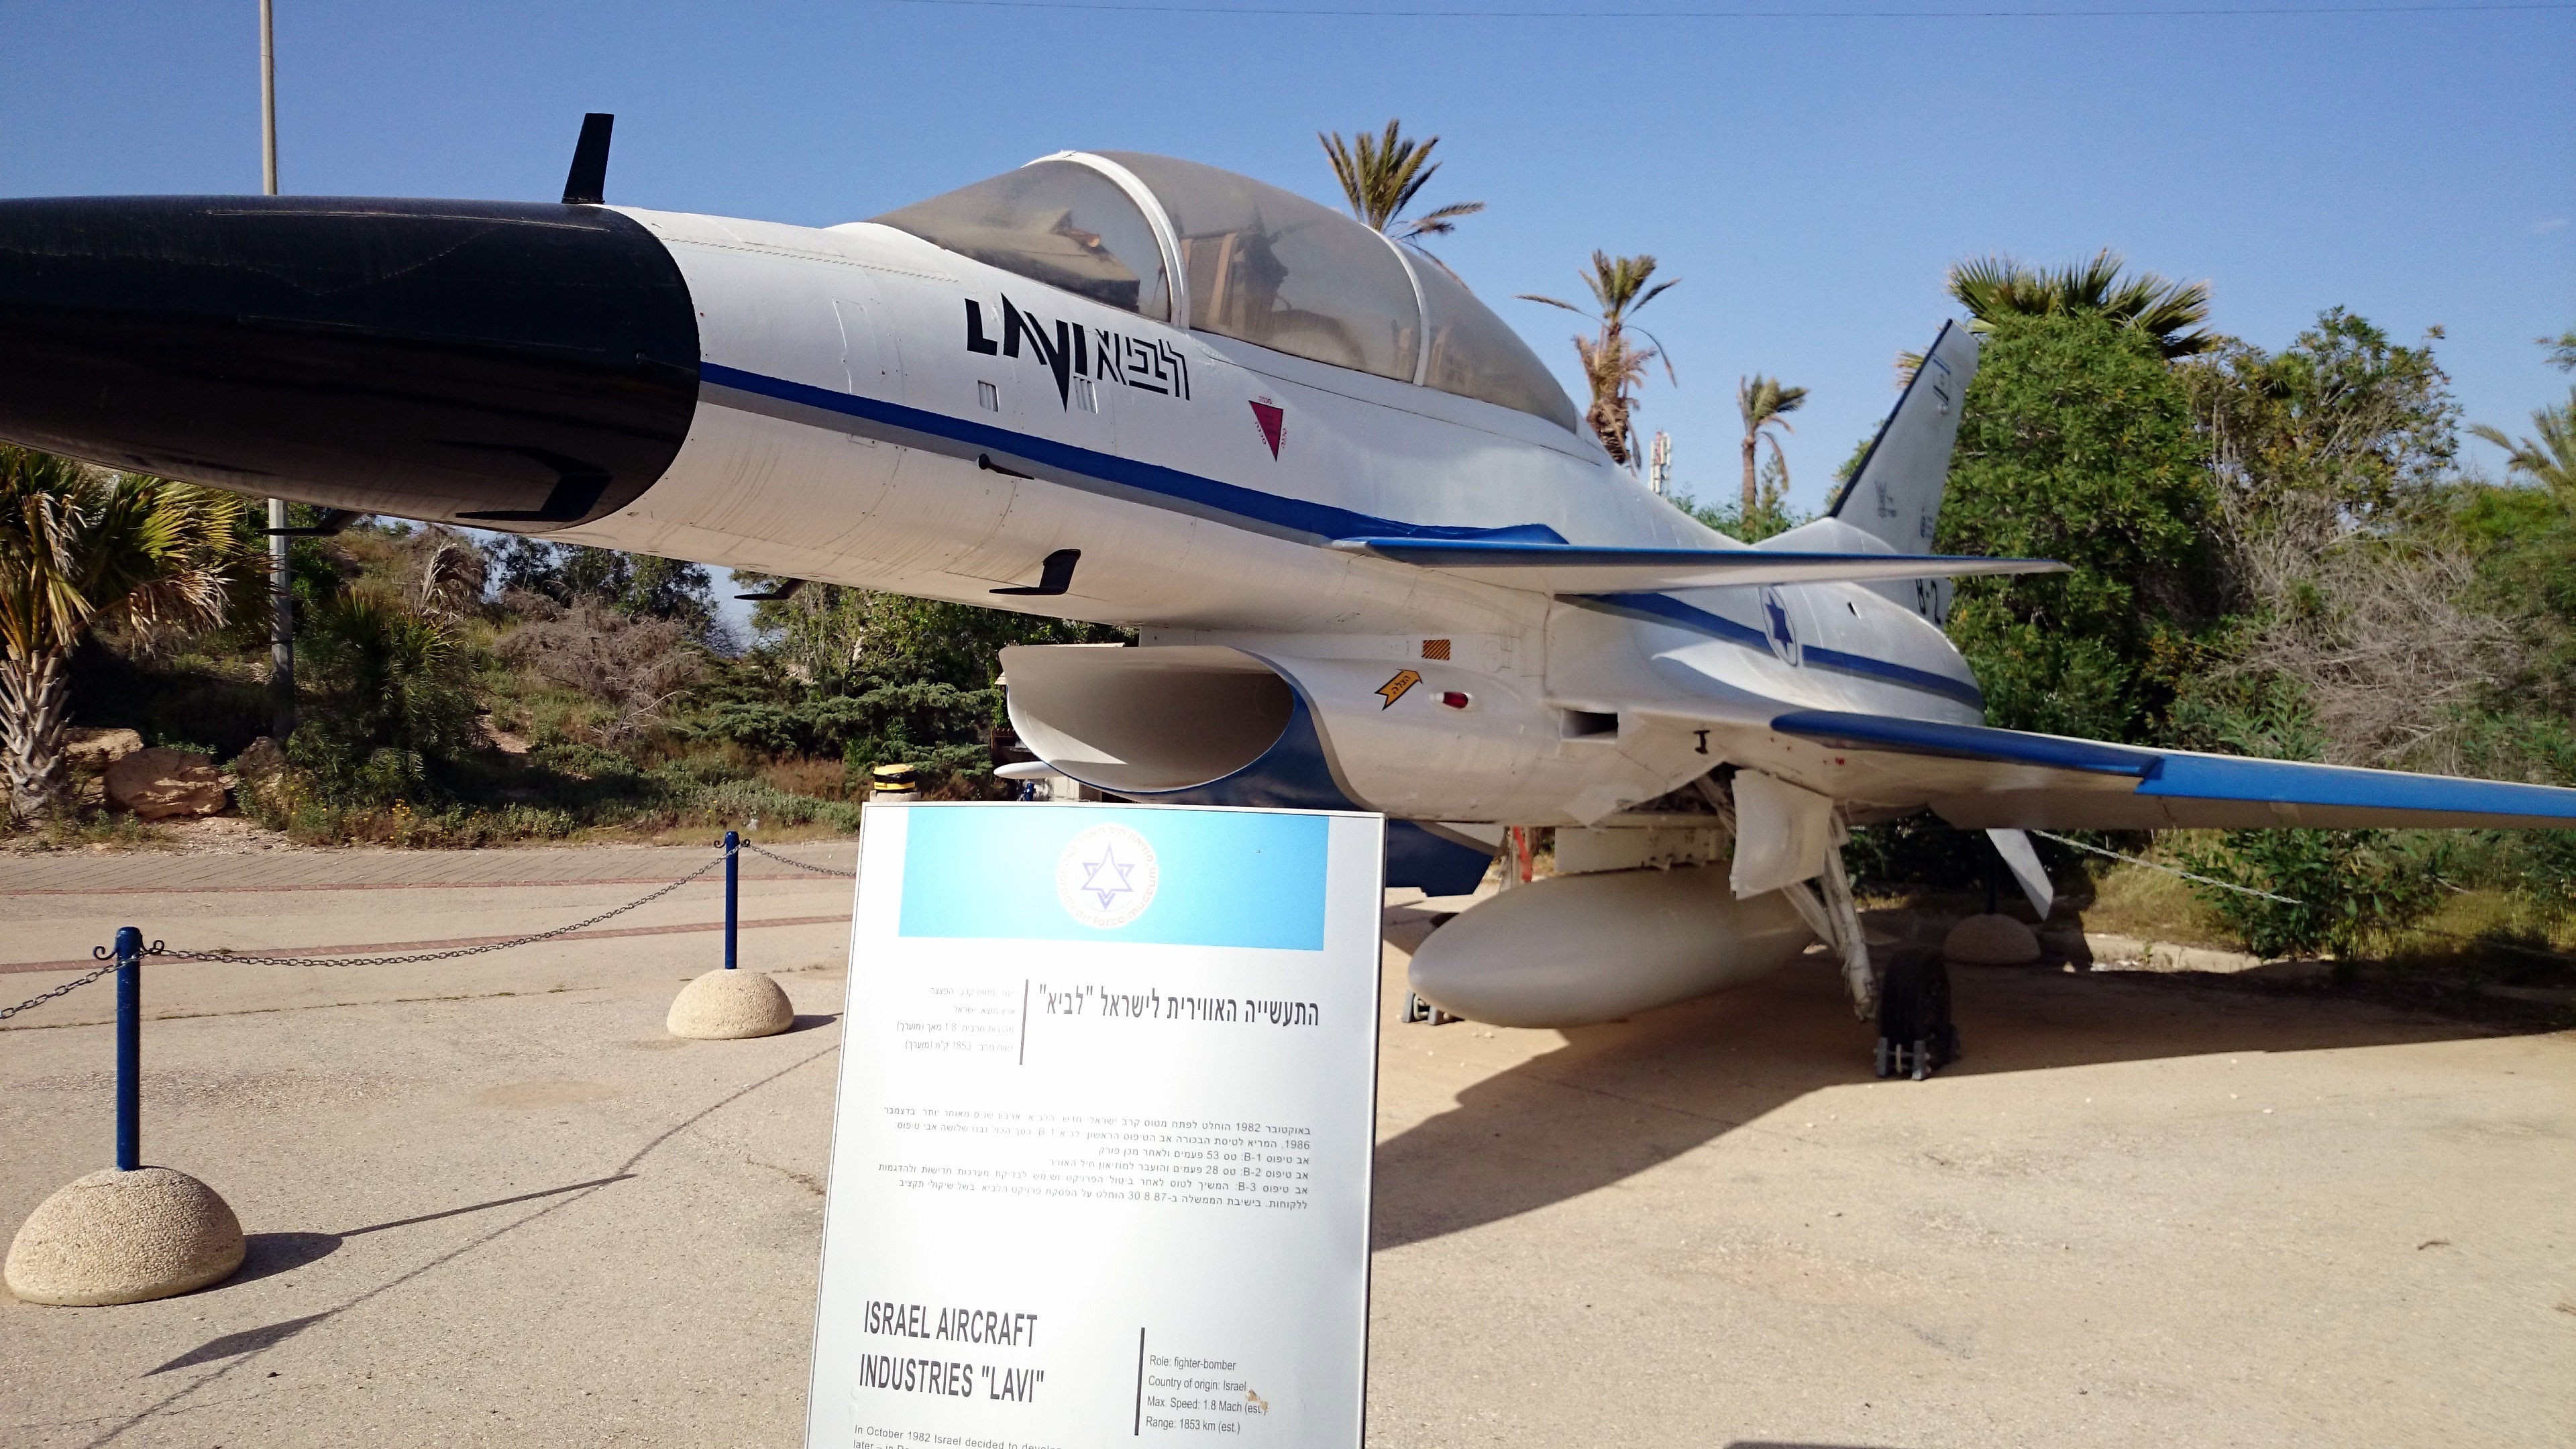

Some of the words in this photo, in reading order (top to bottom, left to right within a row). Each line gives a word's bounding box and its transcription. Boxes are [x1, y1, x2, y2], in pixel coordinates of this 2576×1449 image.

[965, 292, 1087, 413] LAVI
[1040, 984, 1093, 1014] "לביא"
[1101, 986, 1159, 1018] לישראל
[1167, 997, 1236, 1022] האווירית
[1245, 1000, 1318, 1026] התעשייה
[945, 1022, 957, 1031] 18
[945, 1110, 969, 1118] מאוחר
[1122, 1119, 1139, 1128] קרב
[1172, 1120, 1197, 1129] לפתח
[1202, 1121, 1230, 1130] הוחלט
[1236, 1123, 1260, 1132] 1982
[1266, 1126, 1310, 1136] באוקטובר
[1214, 1138, 1243, 1146] לטיסת
[1124, 1148, 1138, 1157] מכן
[1143, 1148, 1169, 1157] ולאחר
[1207, 1150, 1219, 1159] 53
[1081, 1159, 1094, 1167] חיל
[1099, 1161, 1134, 1170] למוזיאון
[878, 1164, 916, 1173] ולהדגמות
[1138, 1164, 1169, 1172] והועבר
[1206, 1165, 1218, 1174] 28
[1110, 1175, 1133, 1185] ביטול
[1140, 1178, 1164, 1186] לאחר
[1171, 1179, 1191, 1188] לטוס
[928, 1180, 953, 1191] שיקולי
[958, 1181, 974, 1190] בשל
[1198, 1182, 1228, 1191] המשיך
[1046, 1189, 1077, 1197] הפסקת
[1081, 1189, 1091, 1197] על
[1097, 1190, 1124, 1199] הוחלט
[1182, 1194, 1222, 1204] הממשלה
[1227, 1199, 1260, 1207] בישיבת
[864, 1301, 930, 1338] ISRAEL
[936, 1307, 1037, 1347] AIRCRAFT
[1150, 1355, 1171, 1366] Role:
[1174, 1357, 1236, 1371] fighter-bomber
[859, 1354, 973, 1397] INDUSTRIES
[982, 1365, 1044, 1403] "LAVI"
[1148, 1376, 1181, 1389] Country
[1184, 1378, 1193, 1388] of
[1194, 1379, 1220, 1391] origin:
[1223, 1380, 1246, 1391] Israel
[1147, 1396, 1167, 1407] Max.
[1171, 1397, 1200, 1409] Speed:
[1203, 1400, 1216, 1410] 1.8
[1219, 1401, 1242, 1412] Mach
[1146, 1416, 1175, 1430] Range:
[1179, 1418, 1200, 1430] 1853
[1203, 1420, 1216, 1430] km
[1218, 1421, 1240, 1434] (est.)
[855, 1425, 863, 1434] In
[867, 1426, 904, 1439] October
[908, 1431, 930, 1442] 1982
[935, 1434, 961, 1446] Israel
[965, 1438, 1004, 1449] decided
[853, 1440, 874, 1449] later
